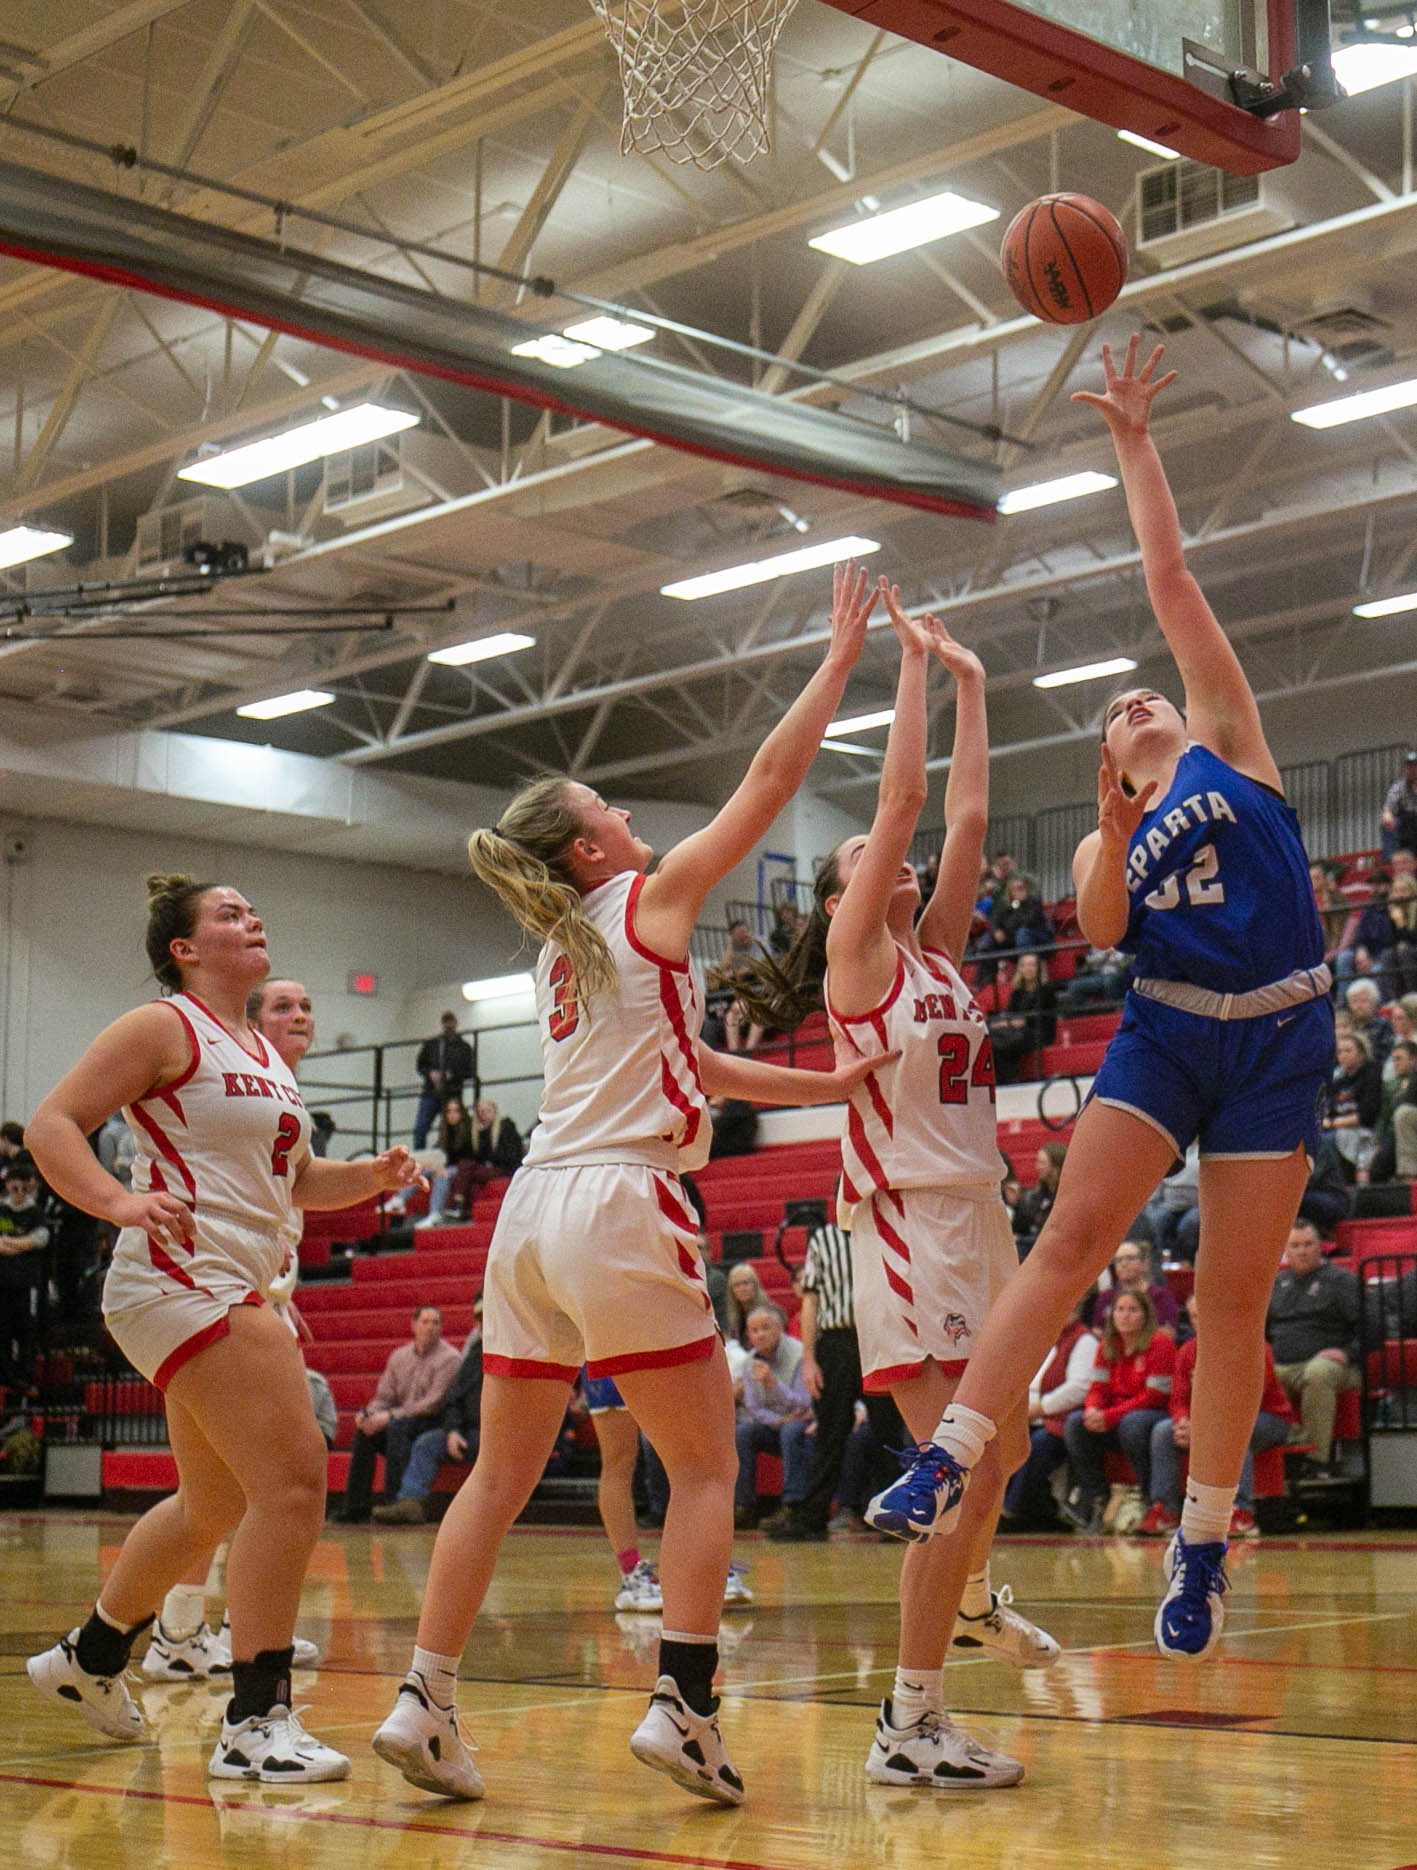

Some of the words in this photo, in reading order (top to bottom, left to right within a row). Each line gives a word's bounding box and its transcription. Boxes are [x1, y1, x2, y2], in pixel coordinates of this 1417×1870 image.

[548, 953, 580, 1044] 3
[221, 1071, 284, 1102] KENT
[937, 1032, 997, 1105] 24
[271, 1111, 301, 1178] 2
